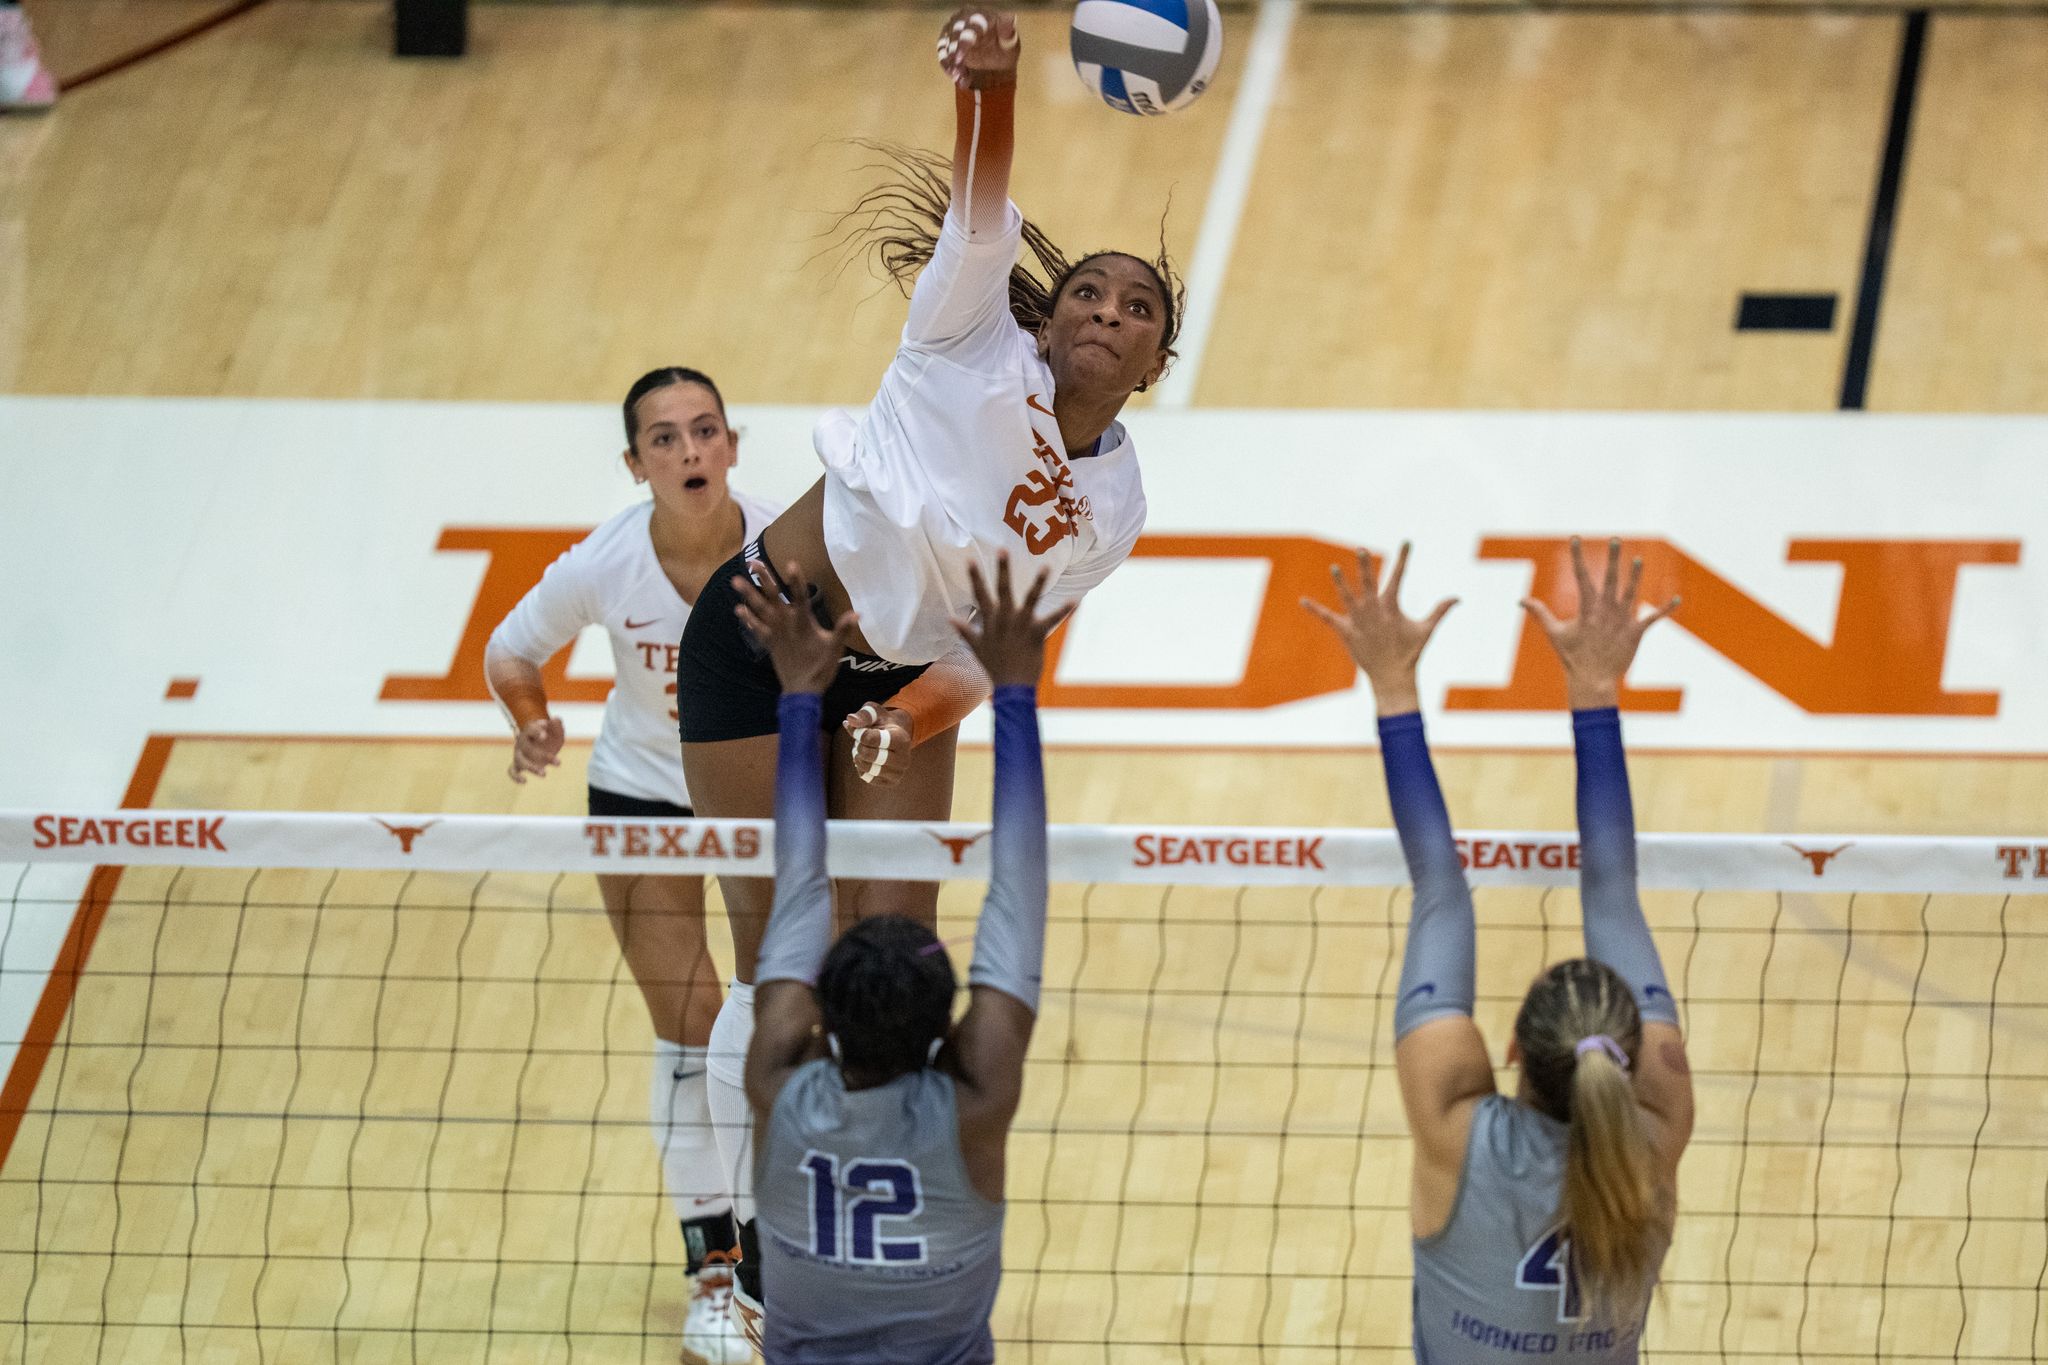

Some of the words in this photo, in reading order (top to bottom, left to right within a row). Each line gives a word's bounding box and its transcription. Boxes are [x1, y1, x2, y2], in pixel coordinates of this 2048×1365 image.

[1002, 469, 1071, 557] 23
[33, 815, 226, 852] SEATGEEK
[584, 823, 761, 860] TEXAS
[1134, 834, 1325, 870] SEATGEEK
[1455, 838, 1581, 871] SEATGE
[798, 1149, 928, 1264] 12
[1514, 1221, 1592, 1324] 4
[1452, 1310, 1559, 1355] HORNED
